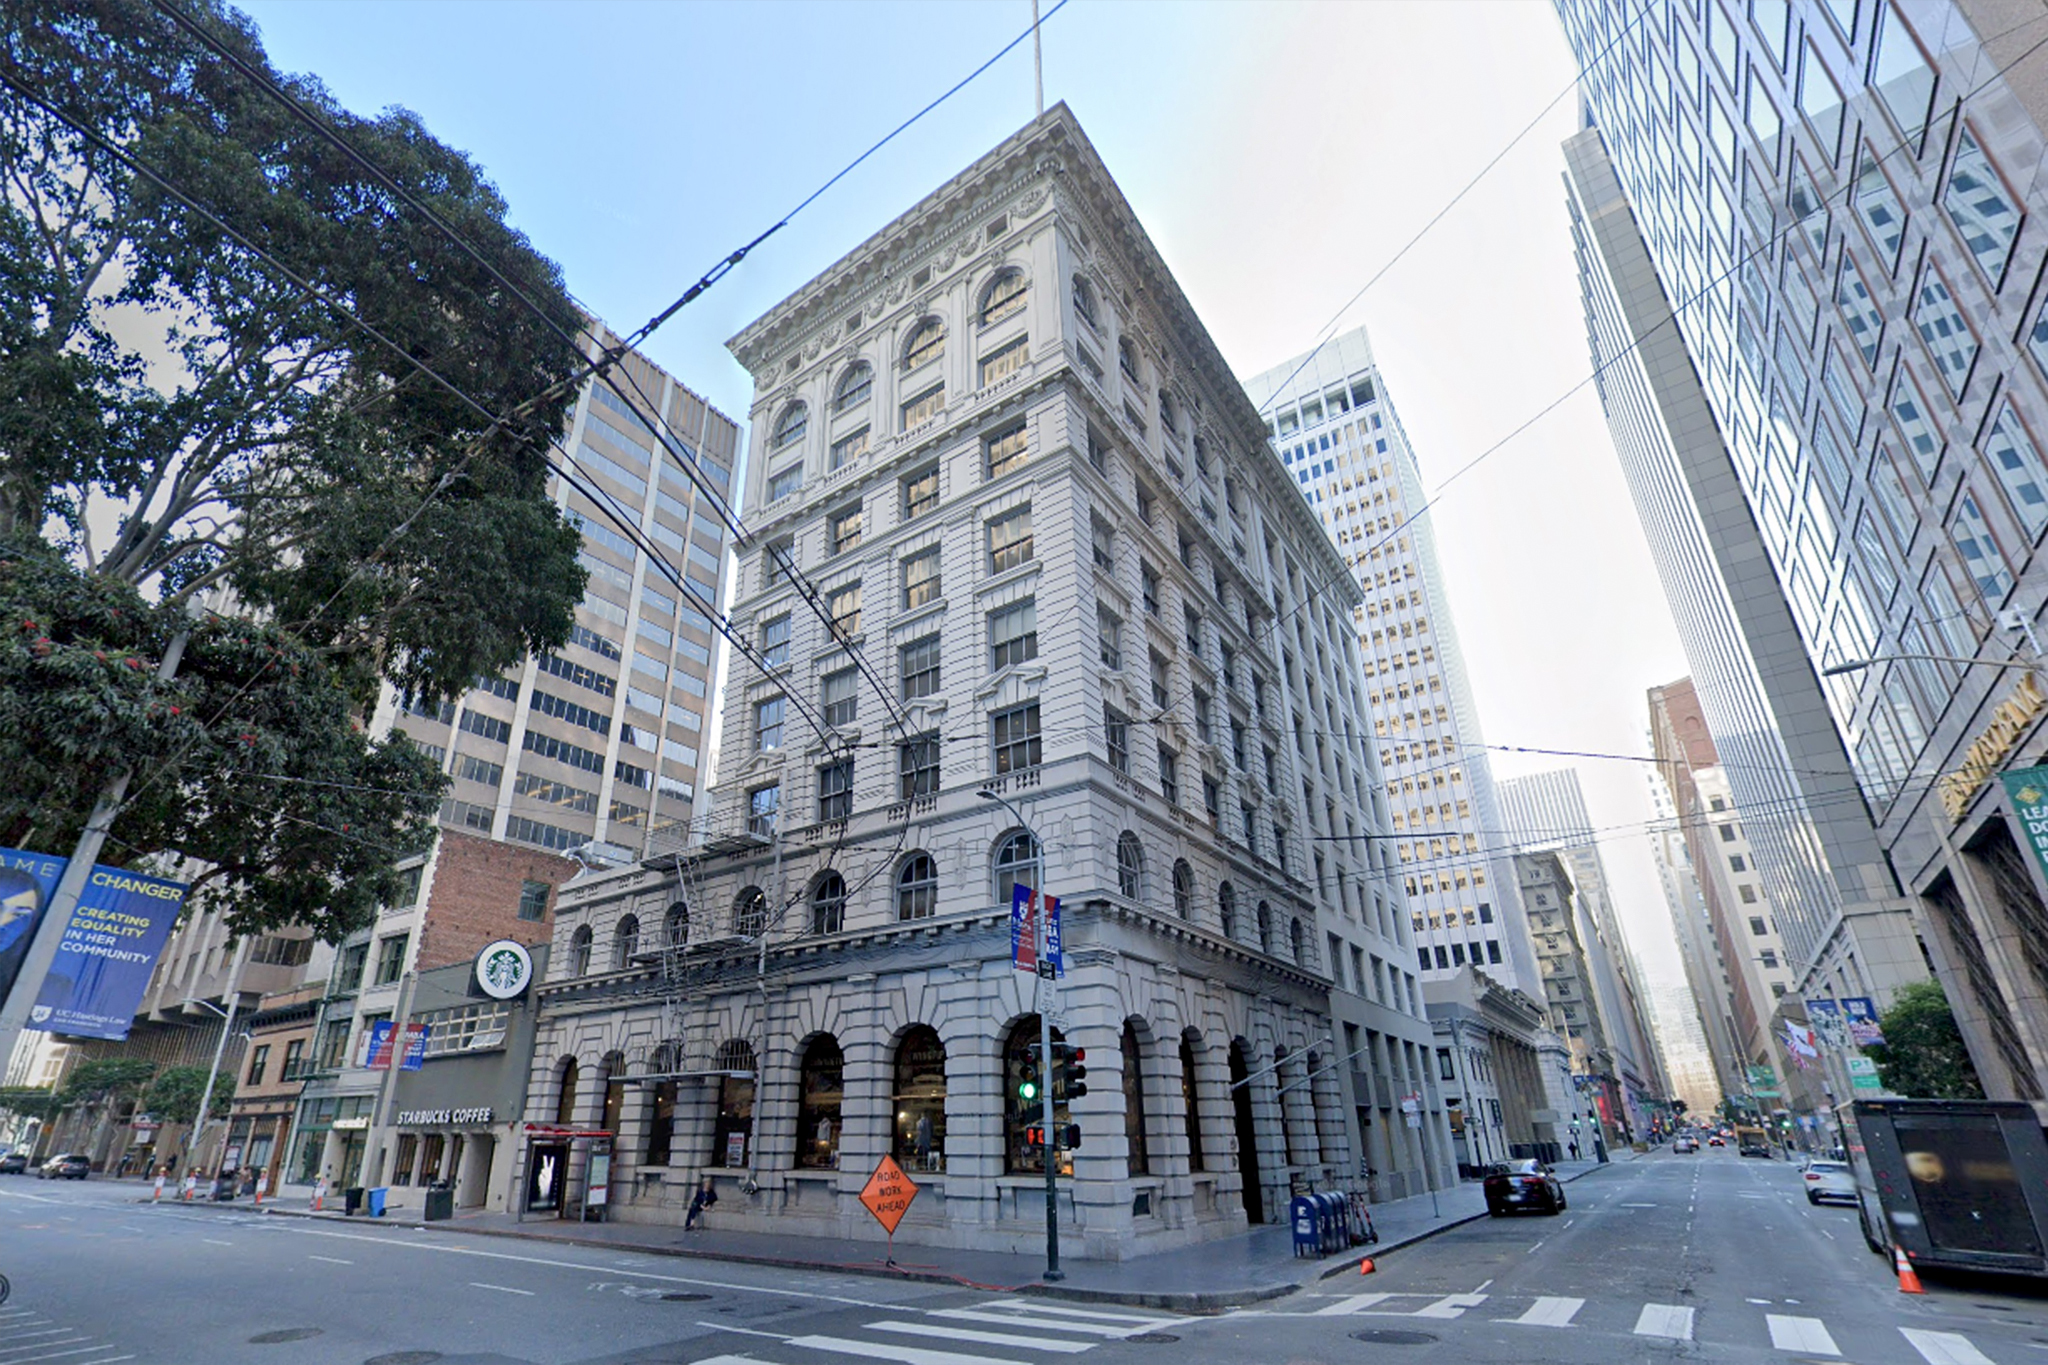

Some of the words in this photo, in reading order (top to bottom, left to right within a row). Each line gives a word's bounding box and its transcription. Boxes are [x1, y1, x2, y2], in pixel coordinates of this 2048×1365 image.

[92, 872, 183, 901] CHANGER
[77, 906, 150, 928] CREATING
[71, 918, 145, 938] EQUALITY
[65, 930, 82, 940] IN
[85, 934, 117, 946] HER
[60, 942, 151, 964] COMMUNITY
[56, 1009, 71, 1018] UC
[397, 1109, 450, 1124] STARBUCKS
[453, 1107, 490, 1123] COFFEE
[877, 1170, 900, 1182] ROAD
[879, 1185, 902, 1197] WORK
[876, 1199, 905, 1213] AHEAD
